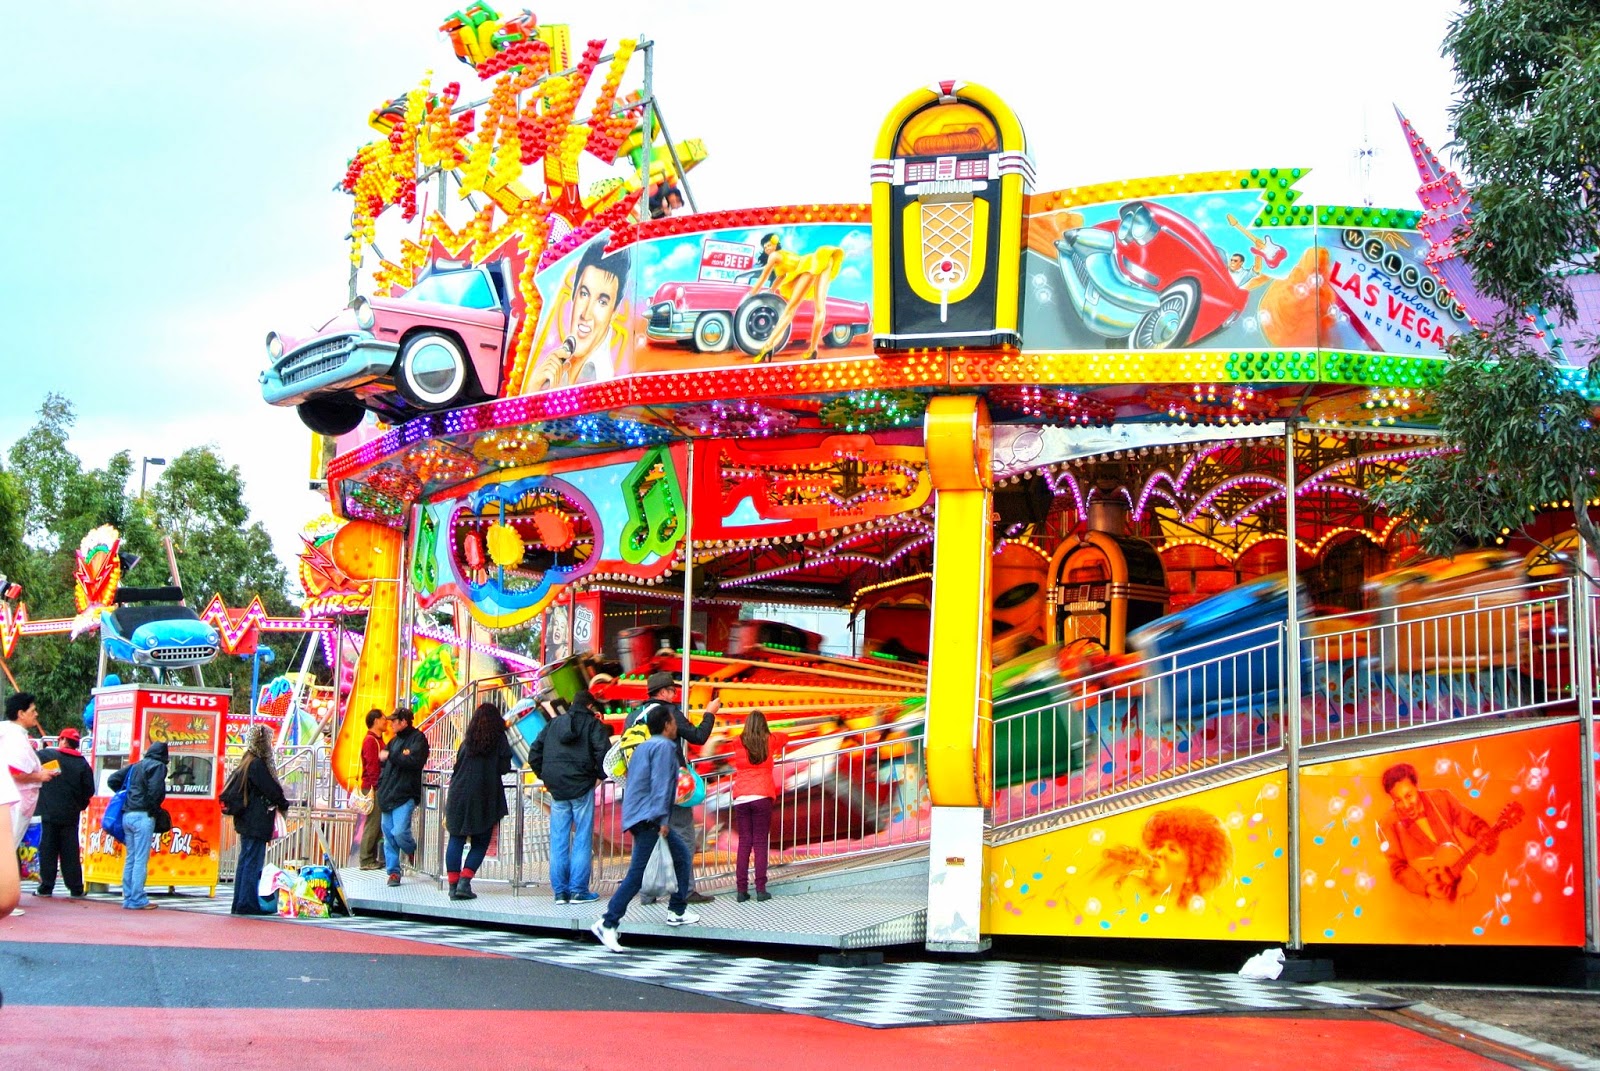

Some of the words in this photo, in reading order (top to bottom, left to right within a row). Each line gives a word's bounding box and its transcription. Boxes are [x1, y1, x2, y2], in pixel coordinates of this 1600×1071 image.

[724, 254, 750, 268] BEEF
[1329, 260, 1380, 307] LAS
[1350, 257, 1366, 272] TO
[1367, 267, 1439, 320] Fabulous
[1364, 310, 1422, 349] NEVADA
[575, 620, 588, 638] 66
[149, 693, 218, 707] TICKETS
[183, 784, 209, 793] THRILL
